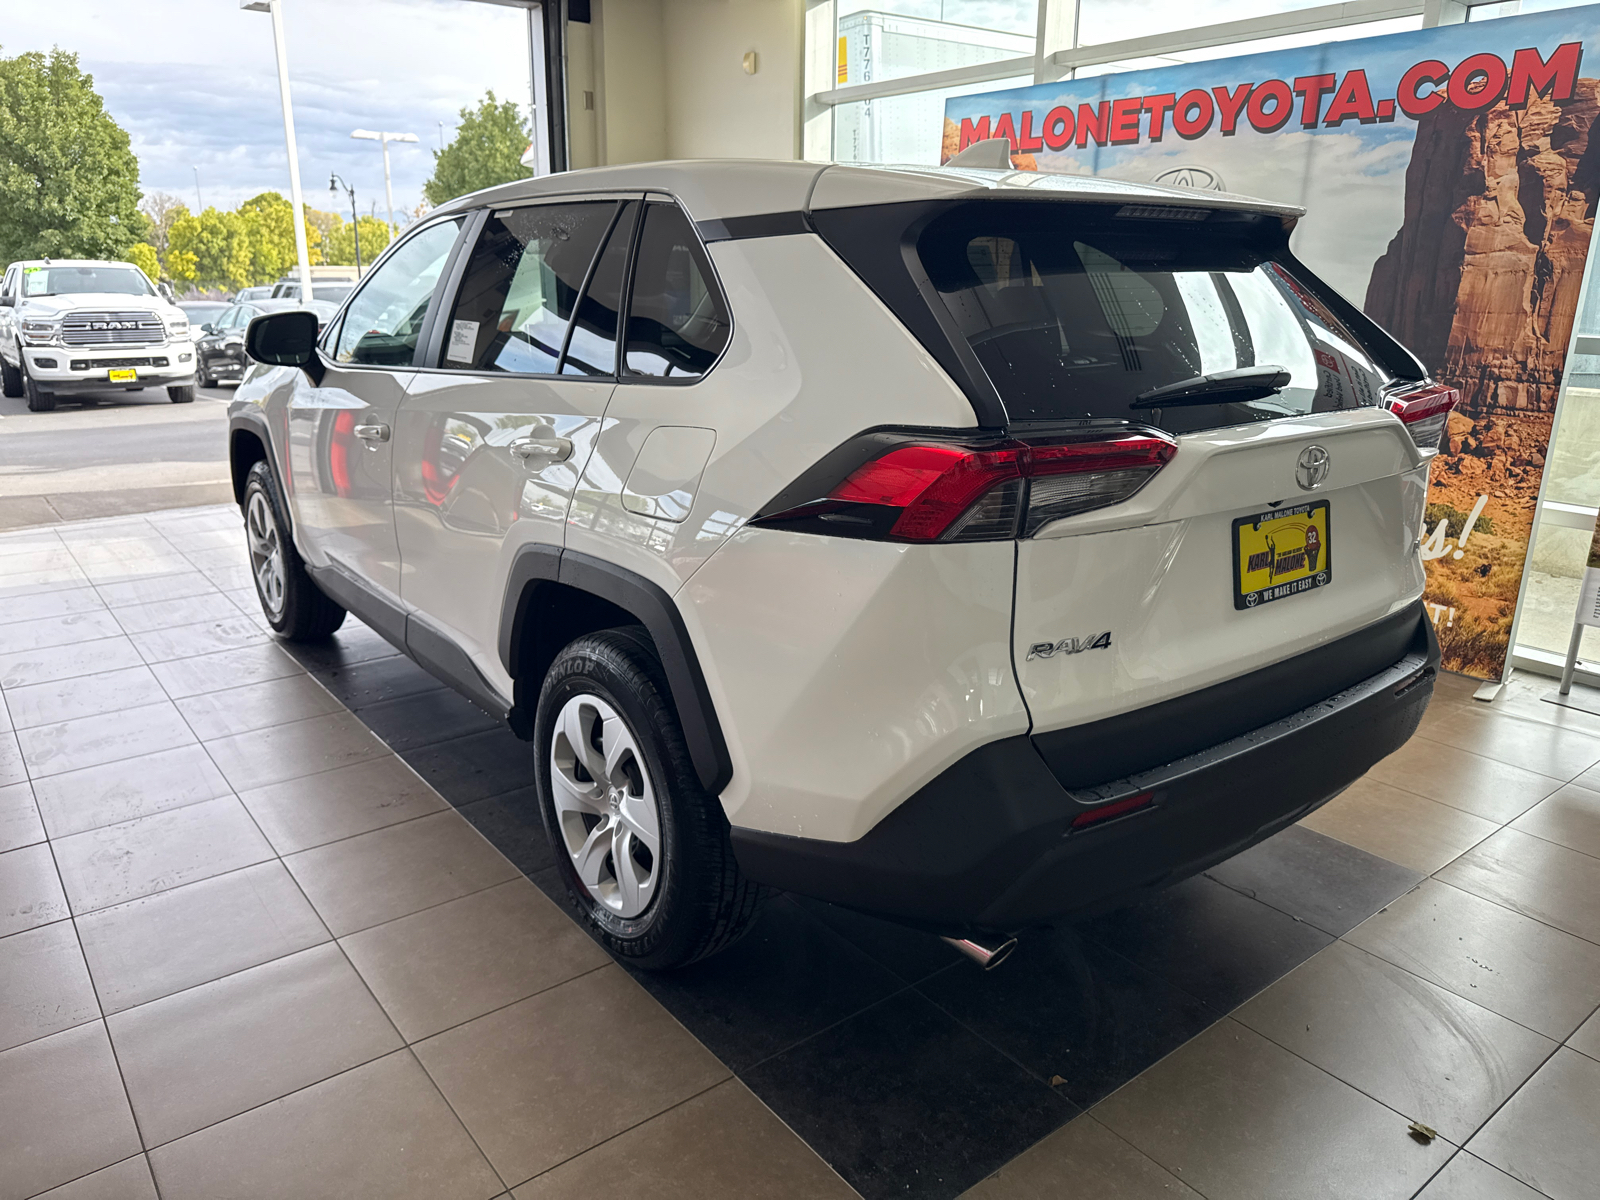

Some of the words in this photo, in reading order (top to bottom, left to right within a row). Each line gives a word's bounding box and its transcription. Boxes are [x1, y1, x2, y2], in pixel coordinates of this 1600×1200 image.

[958, 41, 1585, 153] MALONETOYOTA.COM
[92, 321, 137, 330] RAM
[1260, 513, 1274, 522] KARL
[1274, 508, 1293, 519] MALONE
[1293, 505, 1310, 515] TOYOTA
[1307, 531, 1317, 544] 32
[1246, 551, 1271, 574] KARL
[1274, 551, 1307, 577] MALONE
[1262, 590, 1273, 601] WE
[1274, 586, 1291, 597] MAKE
[1291, 582, 1298, 593] IT
[1298, 577, 1313, 591] EASY
[1025, 630, 1112, 662] RAV4
[545, 659, 595, 694] DUNLOP
